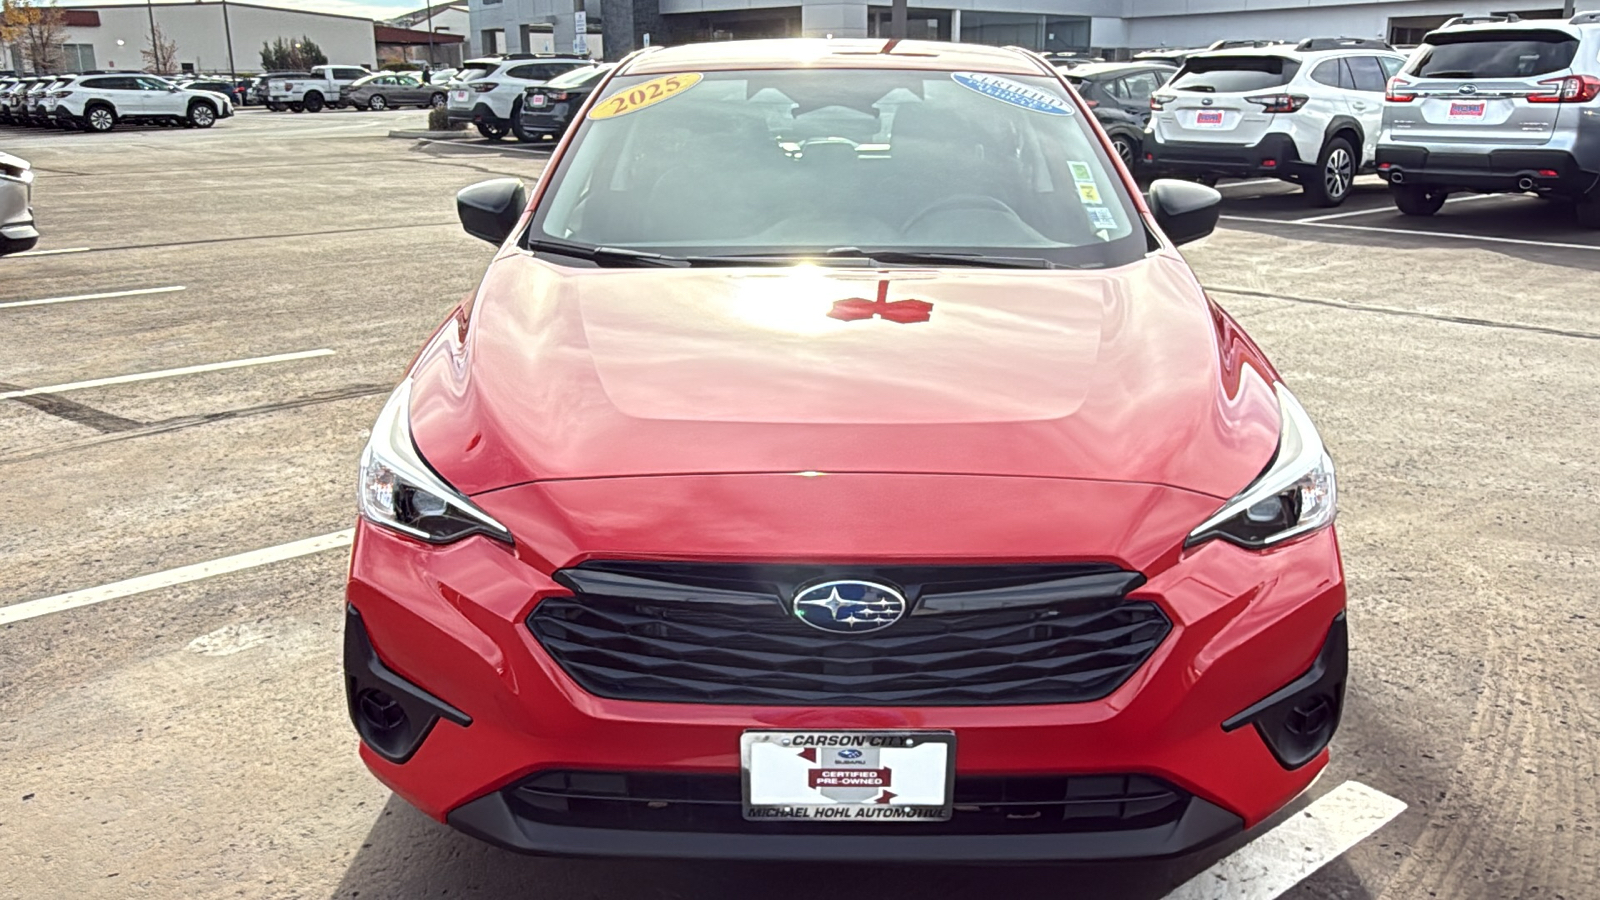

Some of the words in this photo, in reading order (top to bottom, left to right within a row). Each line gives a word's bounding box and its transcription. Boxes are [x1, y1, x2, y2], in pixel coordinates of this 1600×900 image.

[610, 76, 680, 114] 2025
[969, 73, 1063, 107] CERTIFIED
[792, 735, 869, 746] CARSON
[869, 735, 907, 746] CITY
[748, 807, 810, 818] MICHAEL
[814, 807, 852, 818] HOHL
[854, 807, 946, 818] AUTOMOTIVE
